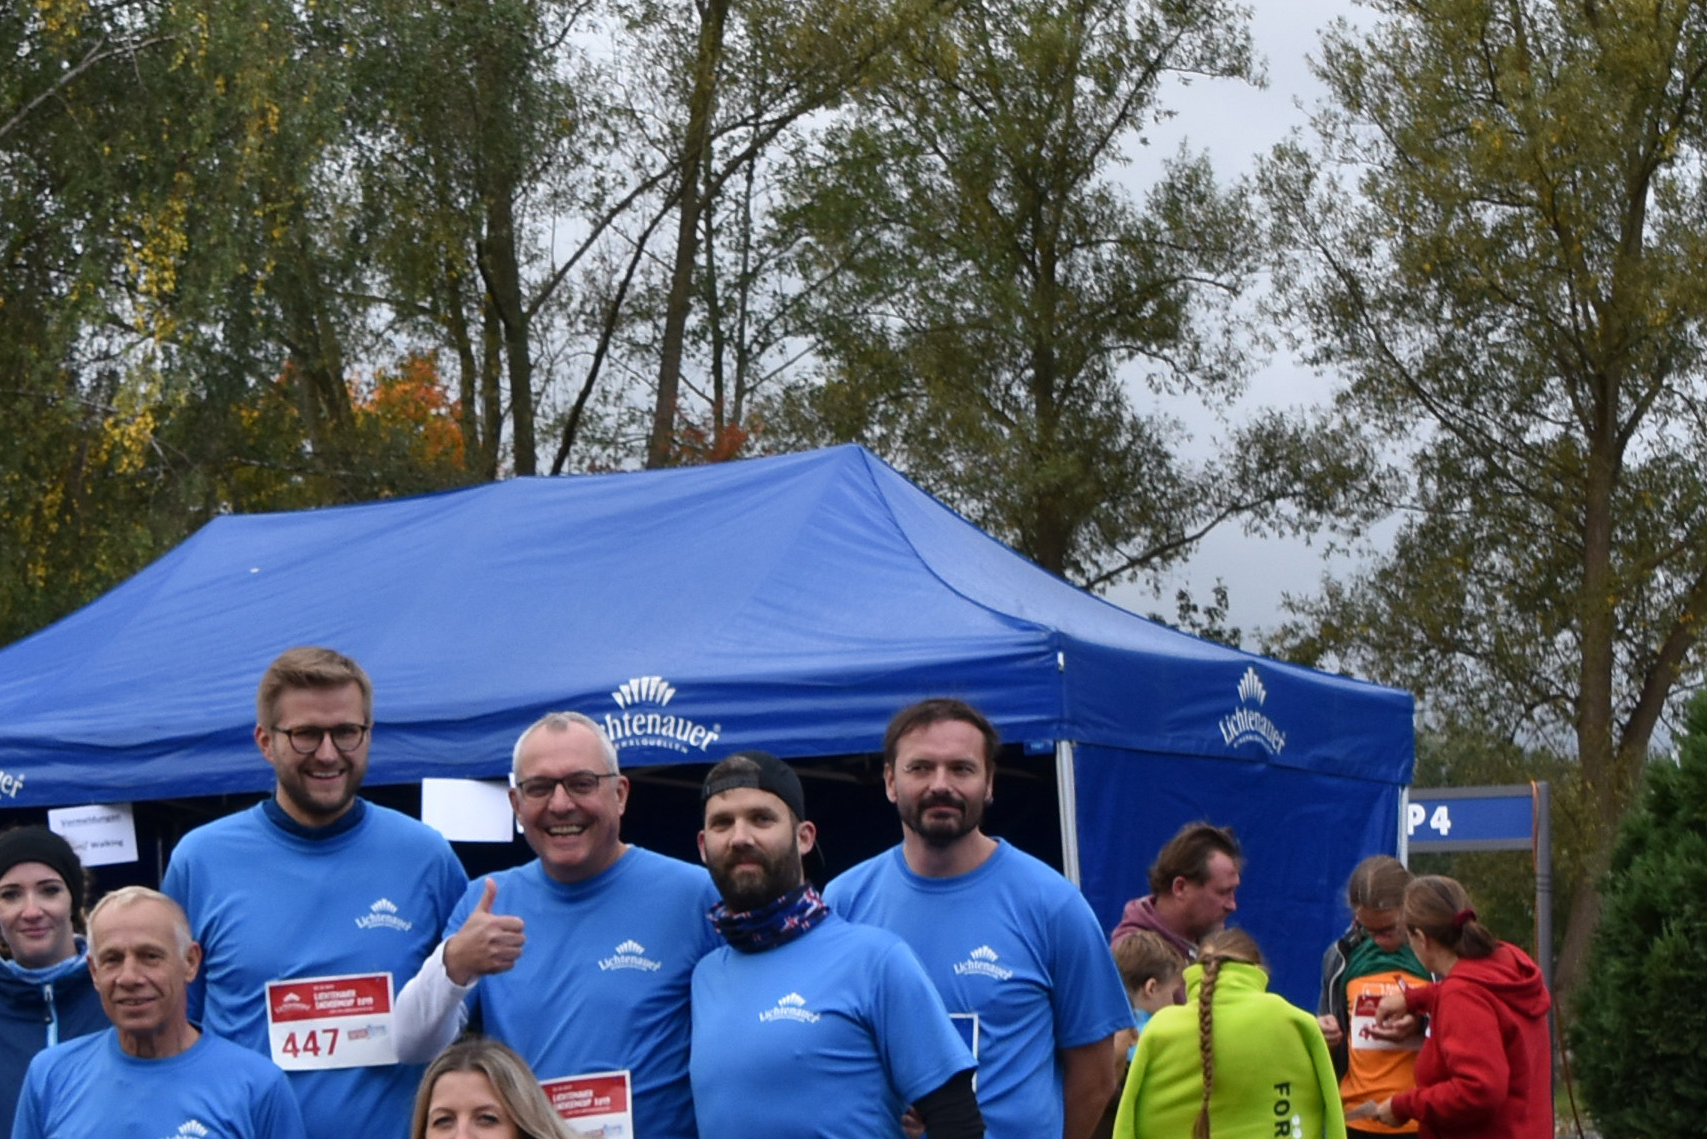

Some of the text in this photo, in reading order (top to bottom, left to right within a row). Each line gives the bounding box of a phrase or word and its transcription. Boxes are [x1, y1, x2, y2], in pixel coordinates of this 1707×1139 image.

[599, 711, 720, 753] htenauer
[1218, 705, 1285, 756] Lichtenauer
[281, 1028, 340, 1058] 447
